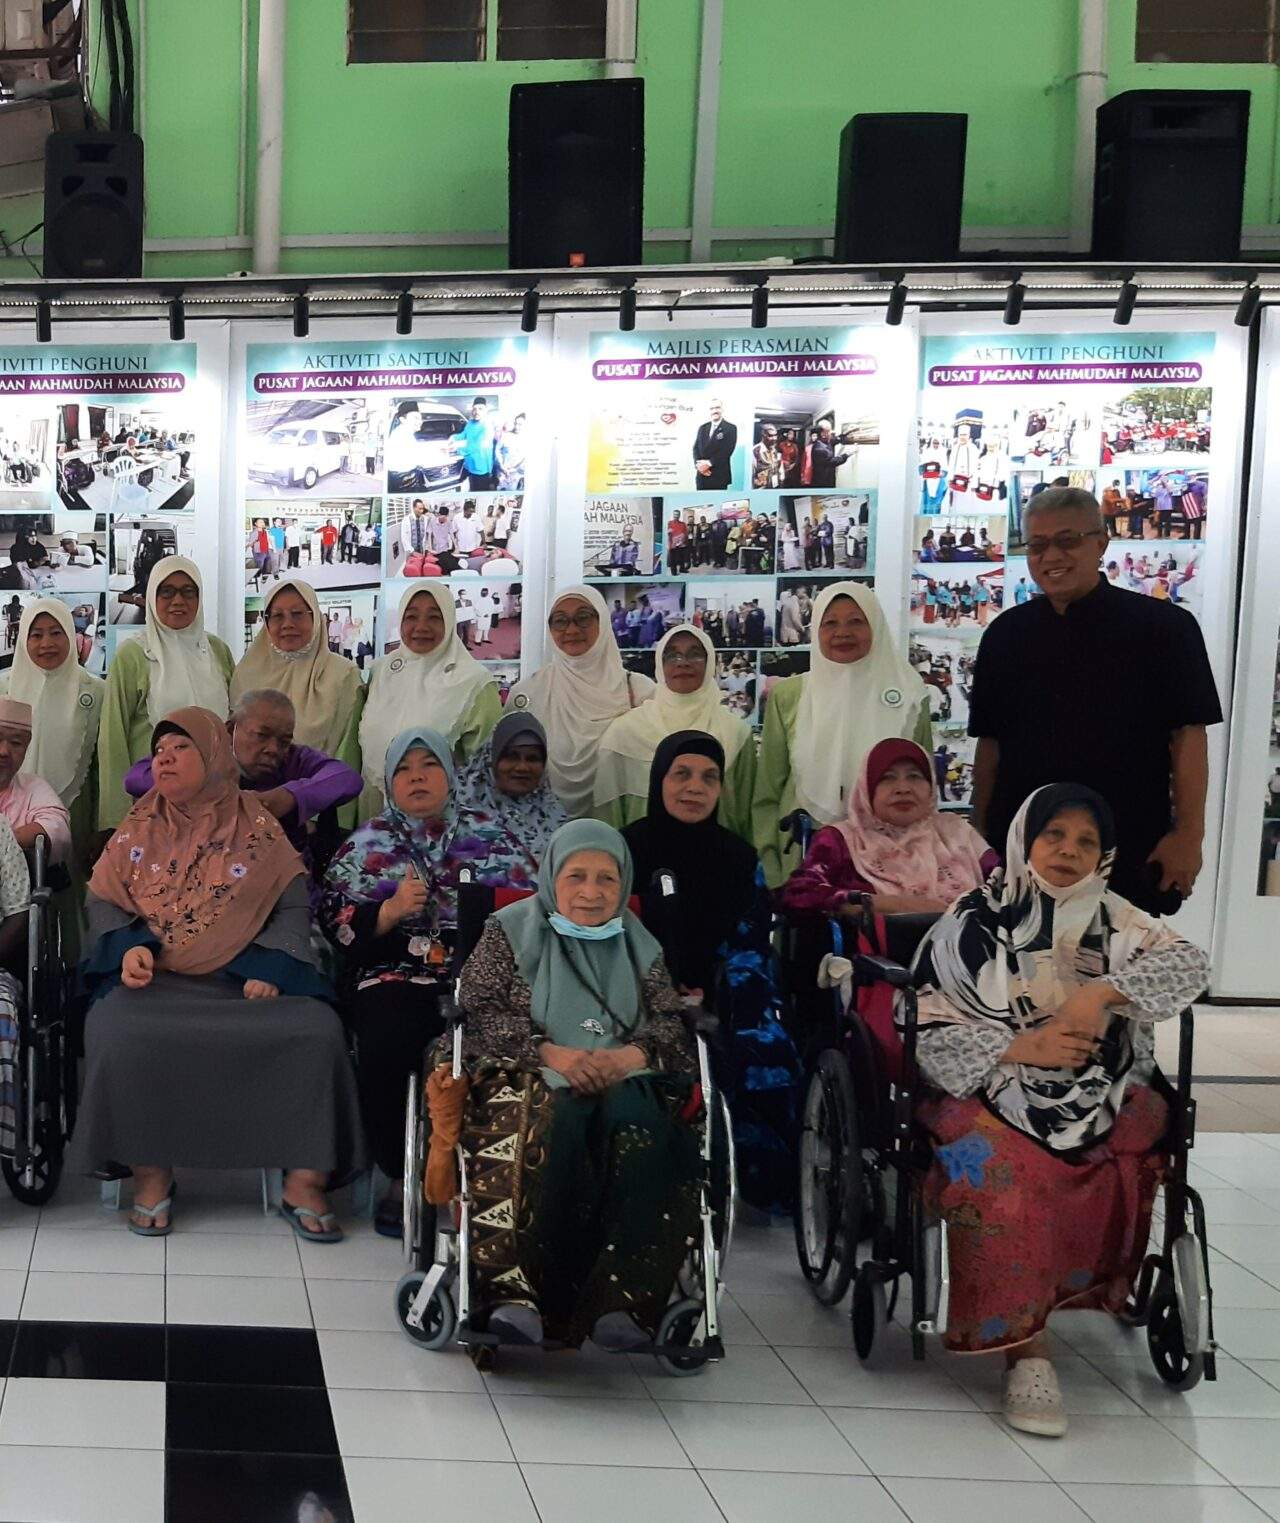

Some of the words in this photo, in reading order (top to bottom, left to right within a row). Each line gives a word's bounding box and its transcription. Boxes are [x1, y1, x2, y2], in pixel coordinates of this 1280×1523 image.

[647, 339, 712, 358] MAJLIS
[720, 337, 829, 354] PERASMIAN
[974, 347, 1053, 361] AKTIVITI
[1061, 345, 1163, 360] PENGHUNI
[51, 356, 147, 371] PENGHUNI
[303, 353, 380, 368] AKTIVITI
[389, 350, 469, 366] SANTUNI
[596, 364, 641, 377] PUSAT
[644, 363, 701, 378] JAGAAN
[705, 360, 799, 374] MAHMUDAH
[803, 359, 878, 372] MALAYSIA
[932, 370, 976, 382] PUSAT
[979, 369, 1034, 384] JAGAAN
[1037, 368, 1128, 381] MAHMUDAH
[1131, 366, 1200, 380] MALAYSIA
[30, 378, 113, 390] MAHMUDAH
[117, 377, 182, 390] MALAYSIA
[258, 376, 300, 389] PUSAT
[302, 376, 353, 391] JAGAAN
[357, 374, 443, 387] MAHMUDAH
[446, 372, 513, 385] MALAYSIA
[590, 500, 629, 512] JAGAAN
[600, 512, 644, 526] MALAYSIA
